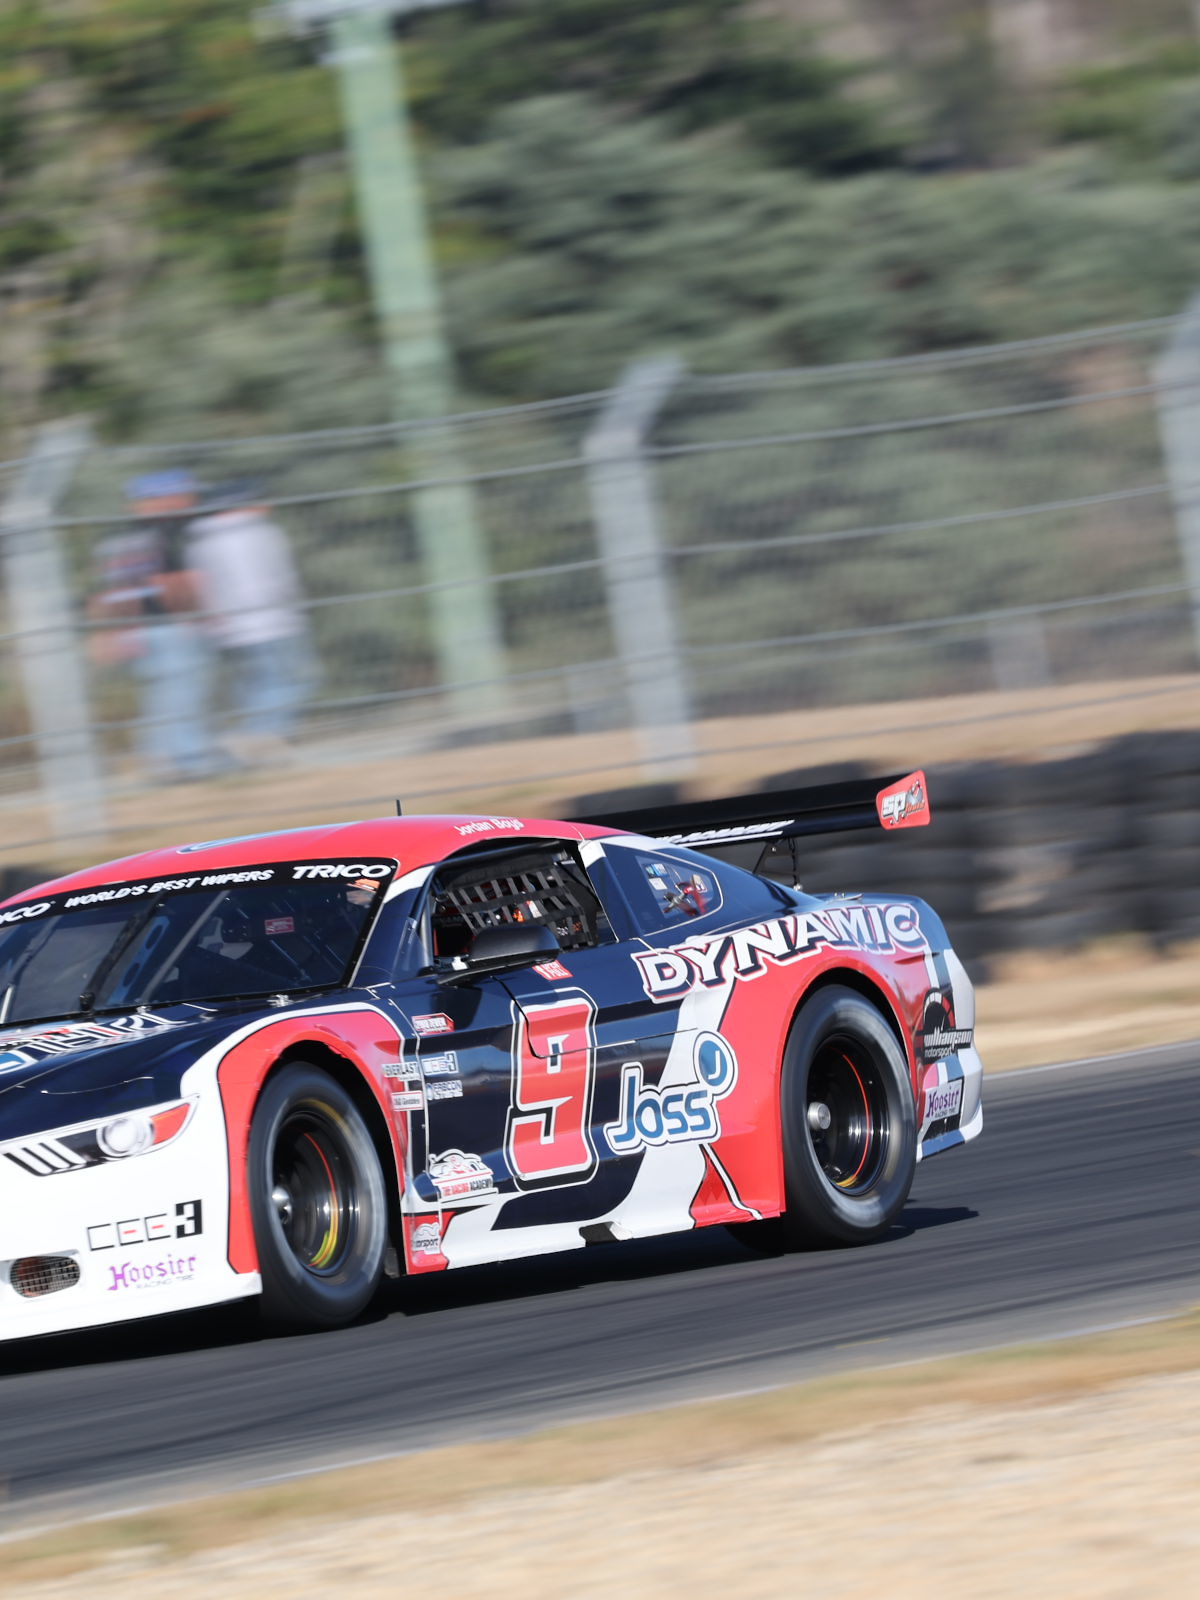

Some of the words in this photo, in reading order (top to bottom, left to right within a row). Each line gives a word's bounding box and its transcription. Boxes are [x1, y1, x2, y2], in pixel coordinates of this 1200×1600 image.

[453, 821, 495, 836] Jordan
[489, 818, 525, 831] Boys
[64, 884, 148, 908] WORLD'S
[147, 877, 201, 893] BEST
[200, 869, 275, 886] WIPERS
[291, 864, 392, 879] TRICO
[636, 904, 926, 1001] DYNAMIC
[509, 996, 594, 1182] 9
[611, 1073, 714, 1146] Joss
[107, 1254, 197, 1291] Hoosier
